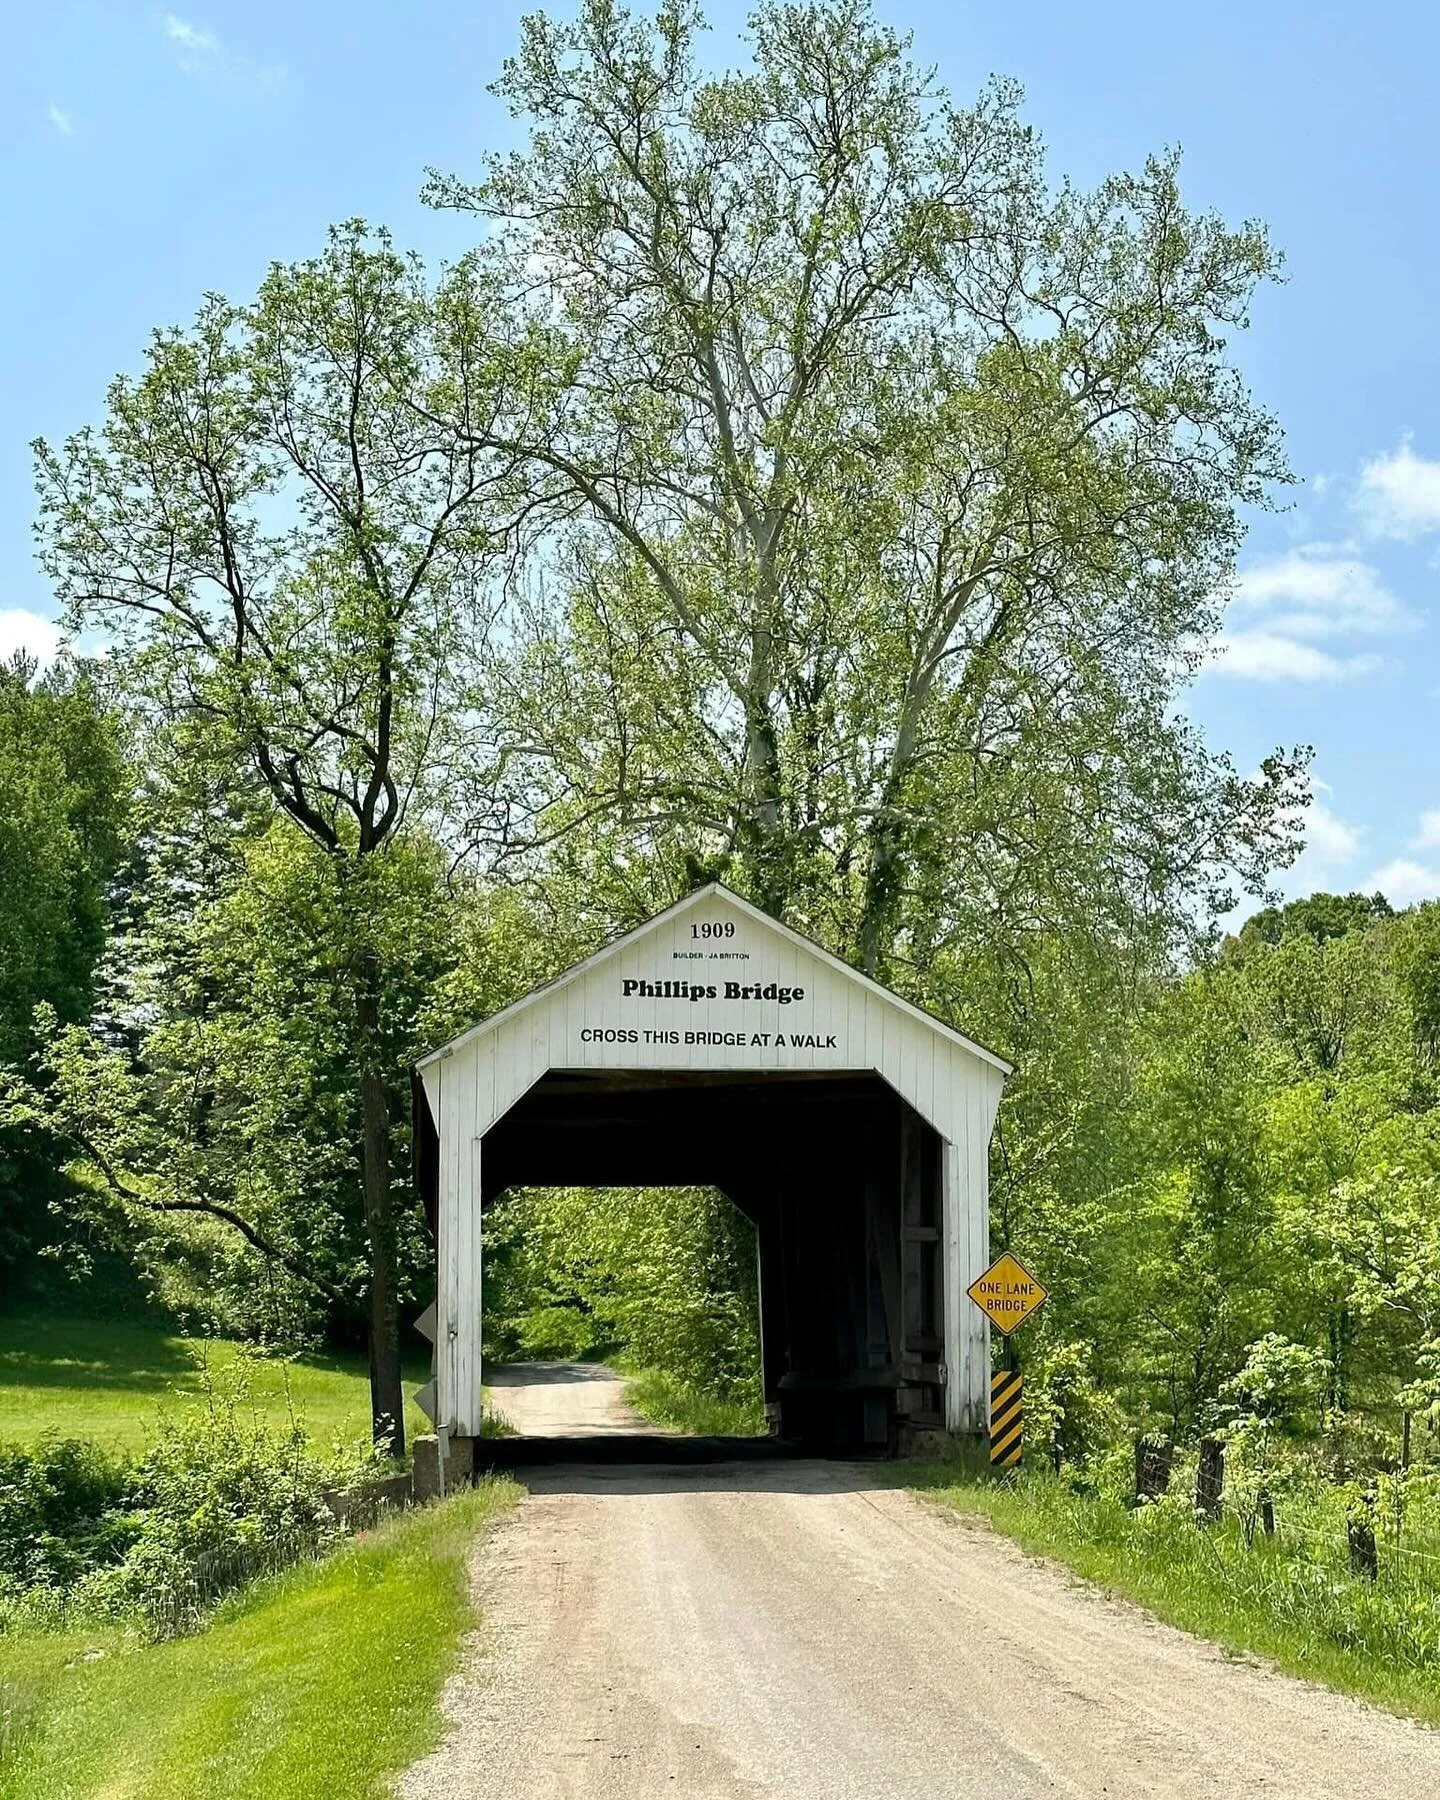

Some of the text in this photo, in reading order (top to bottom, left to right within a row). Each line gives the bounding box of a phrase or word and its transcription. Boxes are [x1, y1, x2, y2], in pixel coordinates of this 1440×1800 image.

[690, 922, 736, 939] 1909
[719, 952, 750, 960] BRITTON
[622, 979, 805, 1004] Phillips Bridge
[580, 1028, 837, 1049] CROSS THIS BRIDGE AT A WALK
[979, 1282, 1035, 1295] ONE LANE
[987, 1299, 1027, 1312] BRIDGE
